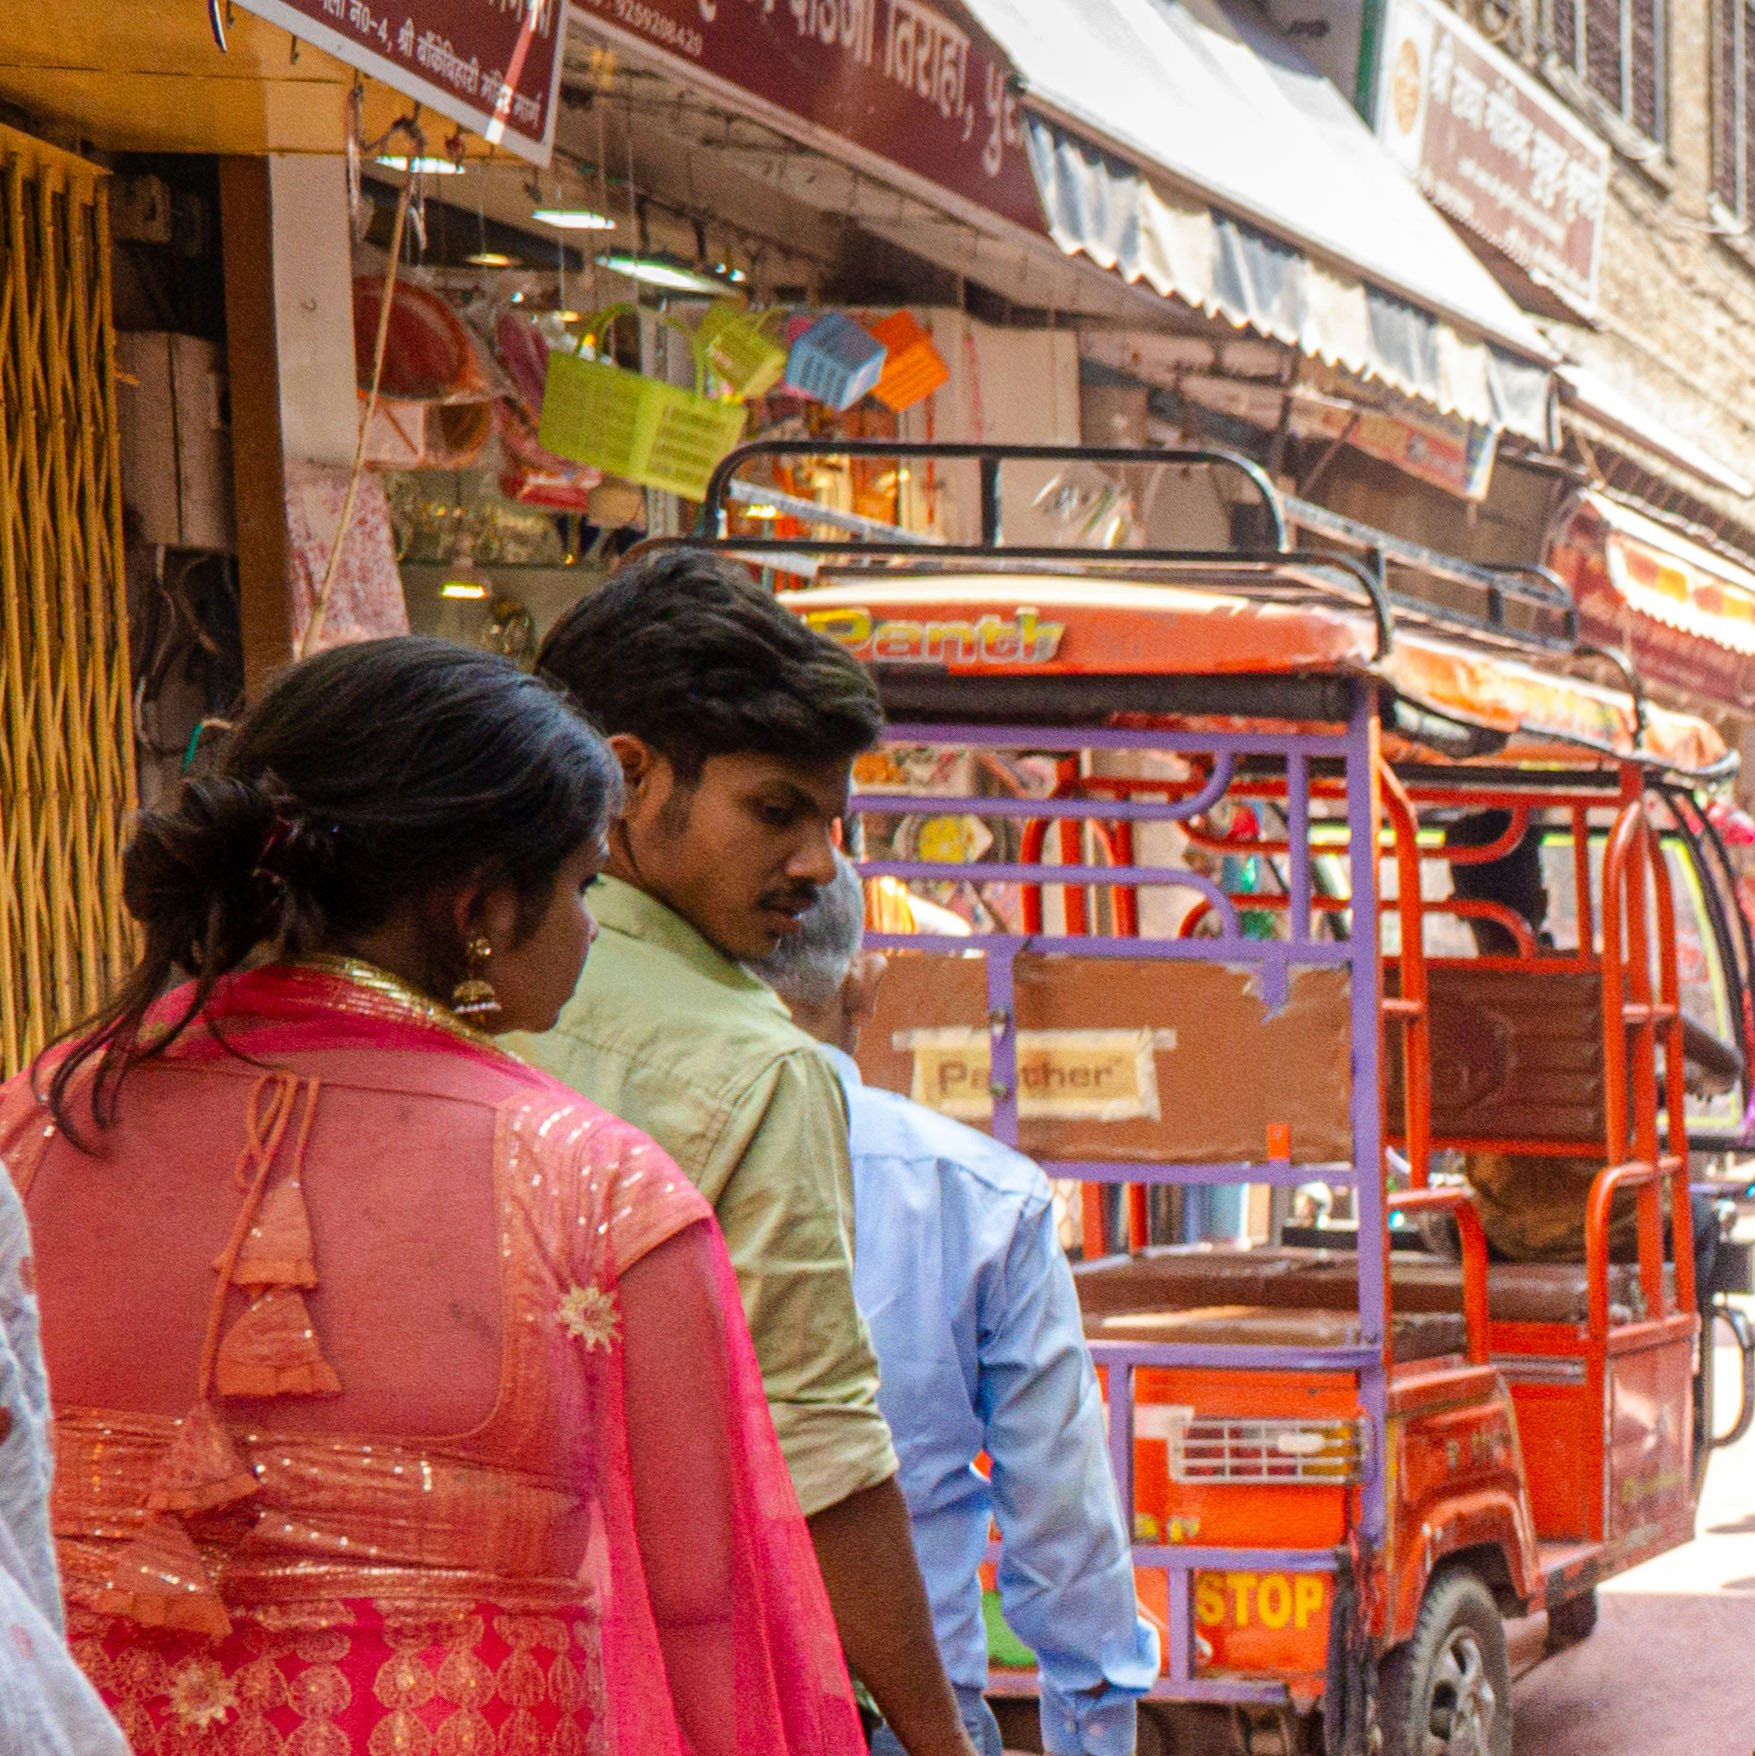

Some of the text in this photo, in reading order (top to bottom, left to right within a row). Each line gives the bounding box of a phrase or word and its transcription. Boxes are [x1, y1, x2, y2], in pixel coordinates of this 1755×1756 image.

[398, 17, 414, 57] श्री
[937, 1056, 1115, 1096] Pather
[1194, 1573, 1328, 1631] STOP
